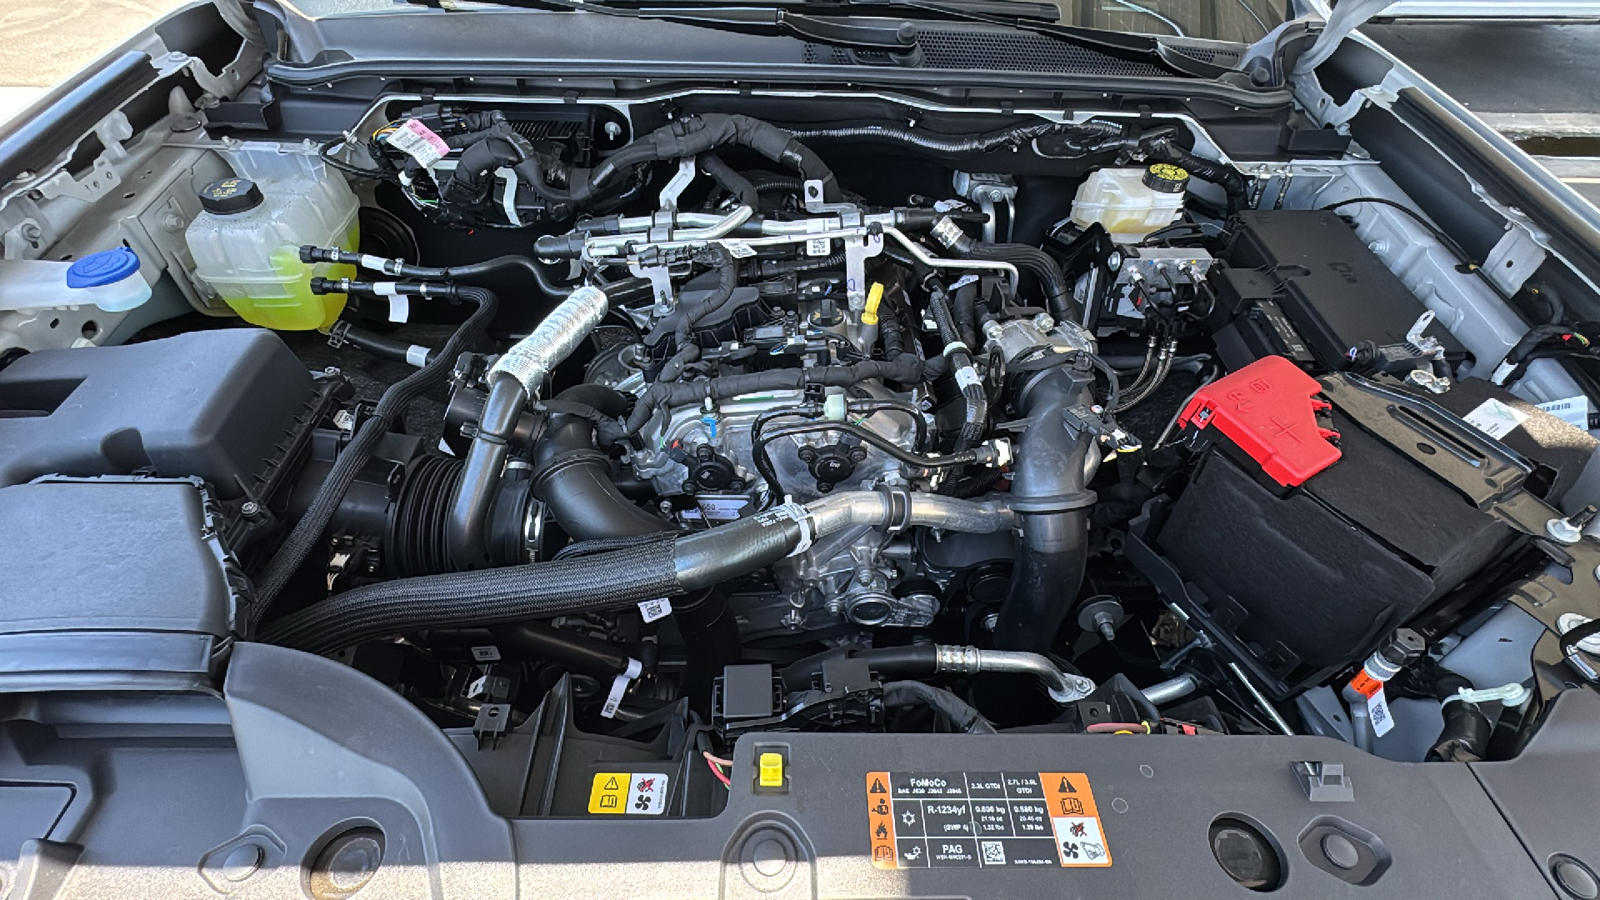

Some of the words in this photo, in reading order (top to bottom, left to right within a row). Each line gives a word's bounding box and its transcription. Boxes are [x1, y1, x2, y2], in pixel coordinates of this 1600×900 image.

[910, 778, 947, 787] FoMoCo
[927, 805, 966, 816] R-1234yf
[996, 806, 1006, 814] kg
[1034, 806, 1044, 814] kg
[942, 845, 963, 853] PAG
